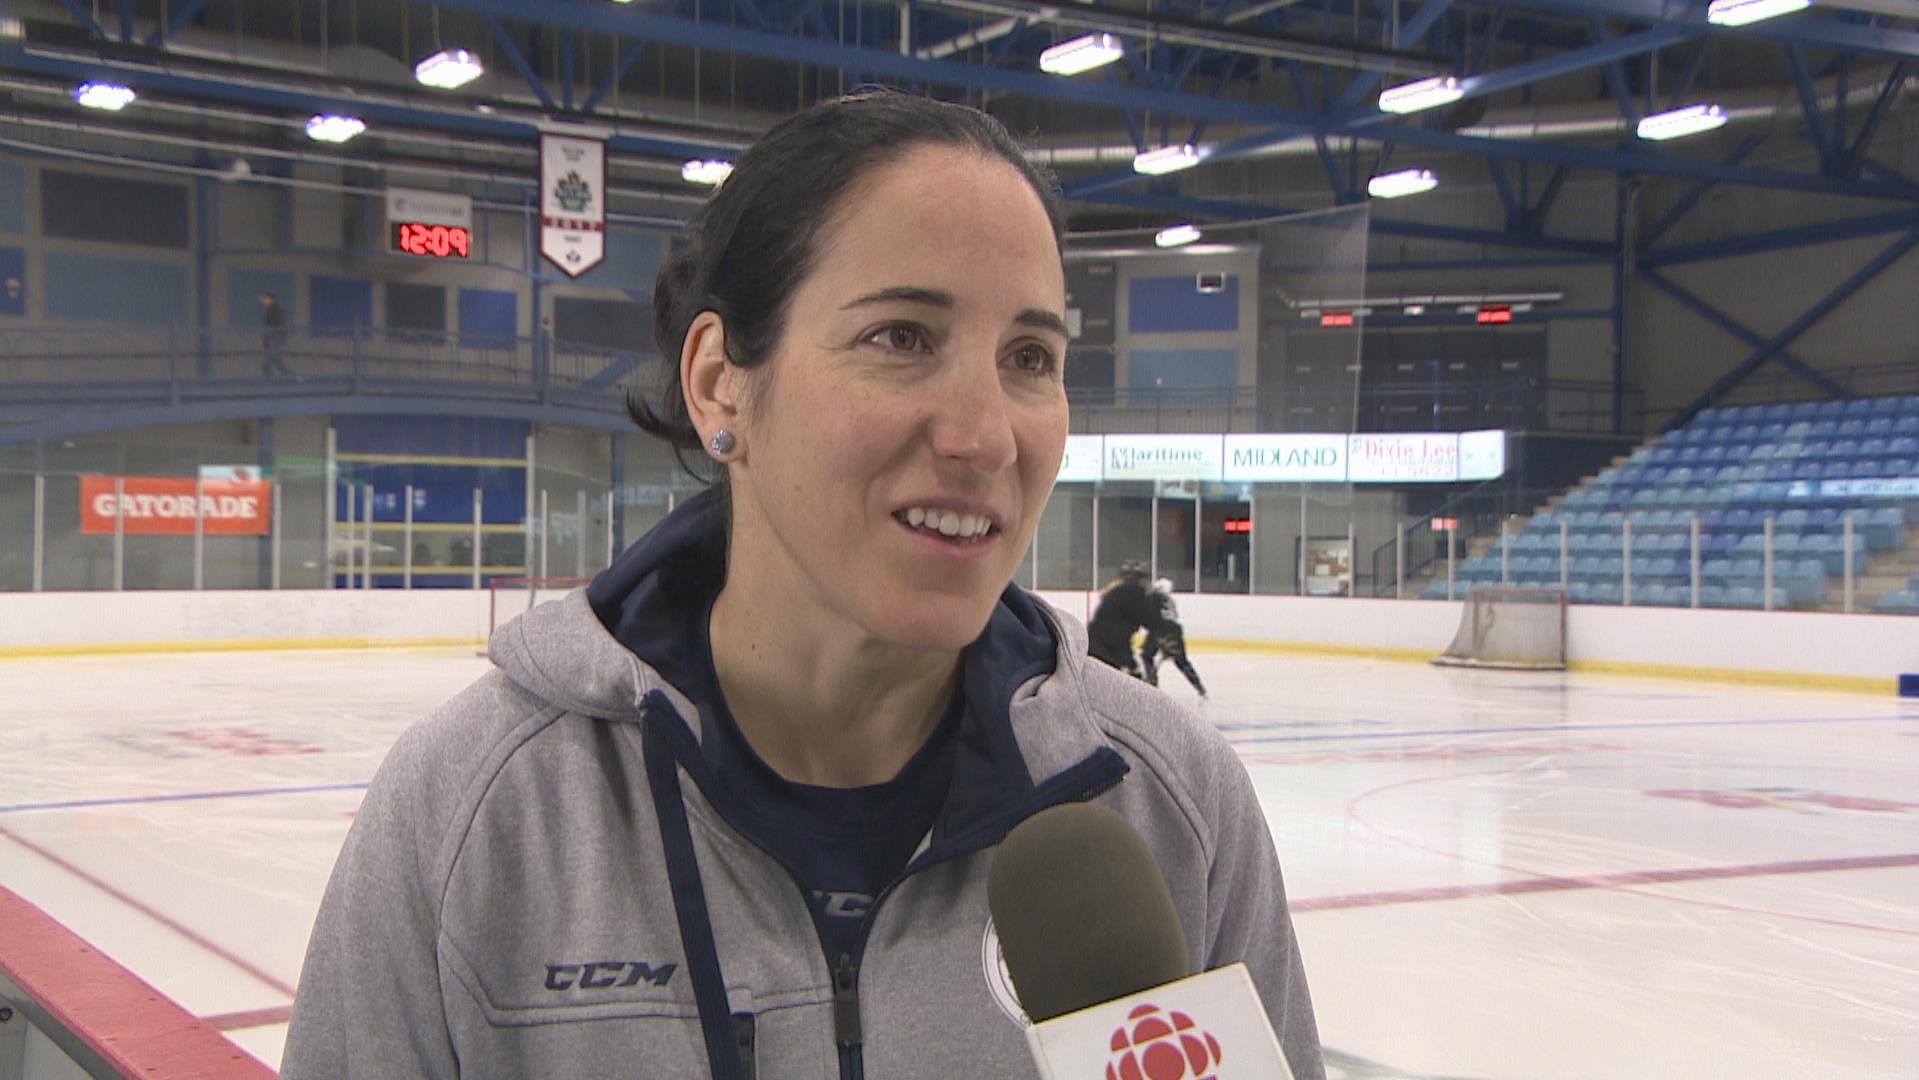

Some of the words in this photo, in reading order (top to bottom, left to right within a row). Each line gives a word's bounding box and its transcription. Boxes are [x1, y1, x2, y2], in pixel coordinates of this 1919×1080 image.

[400, 223, 468, 257] 12:09
[1110, 447, 1204, 470] Maritime
[1233, 447, 1338, 467] MIDLAND
[1365, 438, 1413, 458] Dixie
[1423, 438, 1456, 458] Lee
[93, 493, 259, 519] GATORADE
[544, 961, 678, 991] CCM
